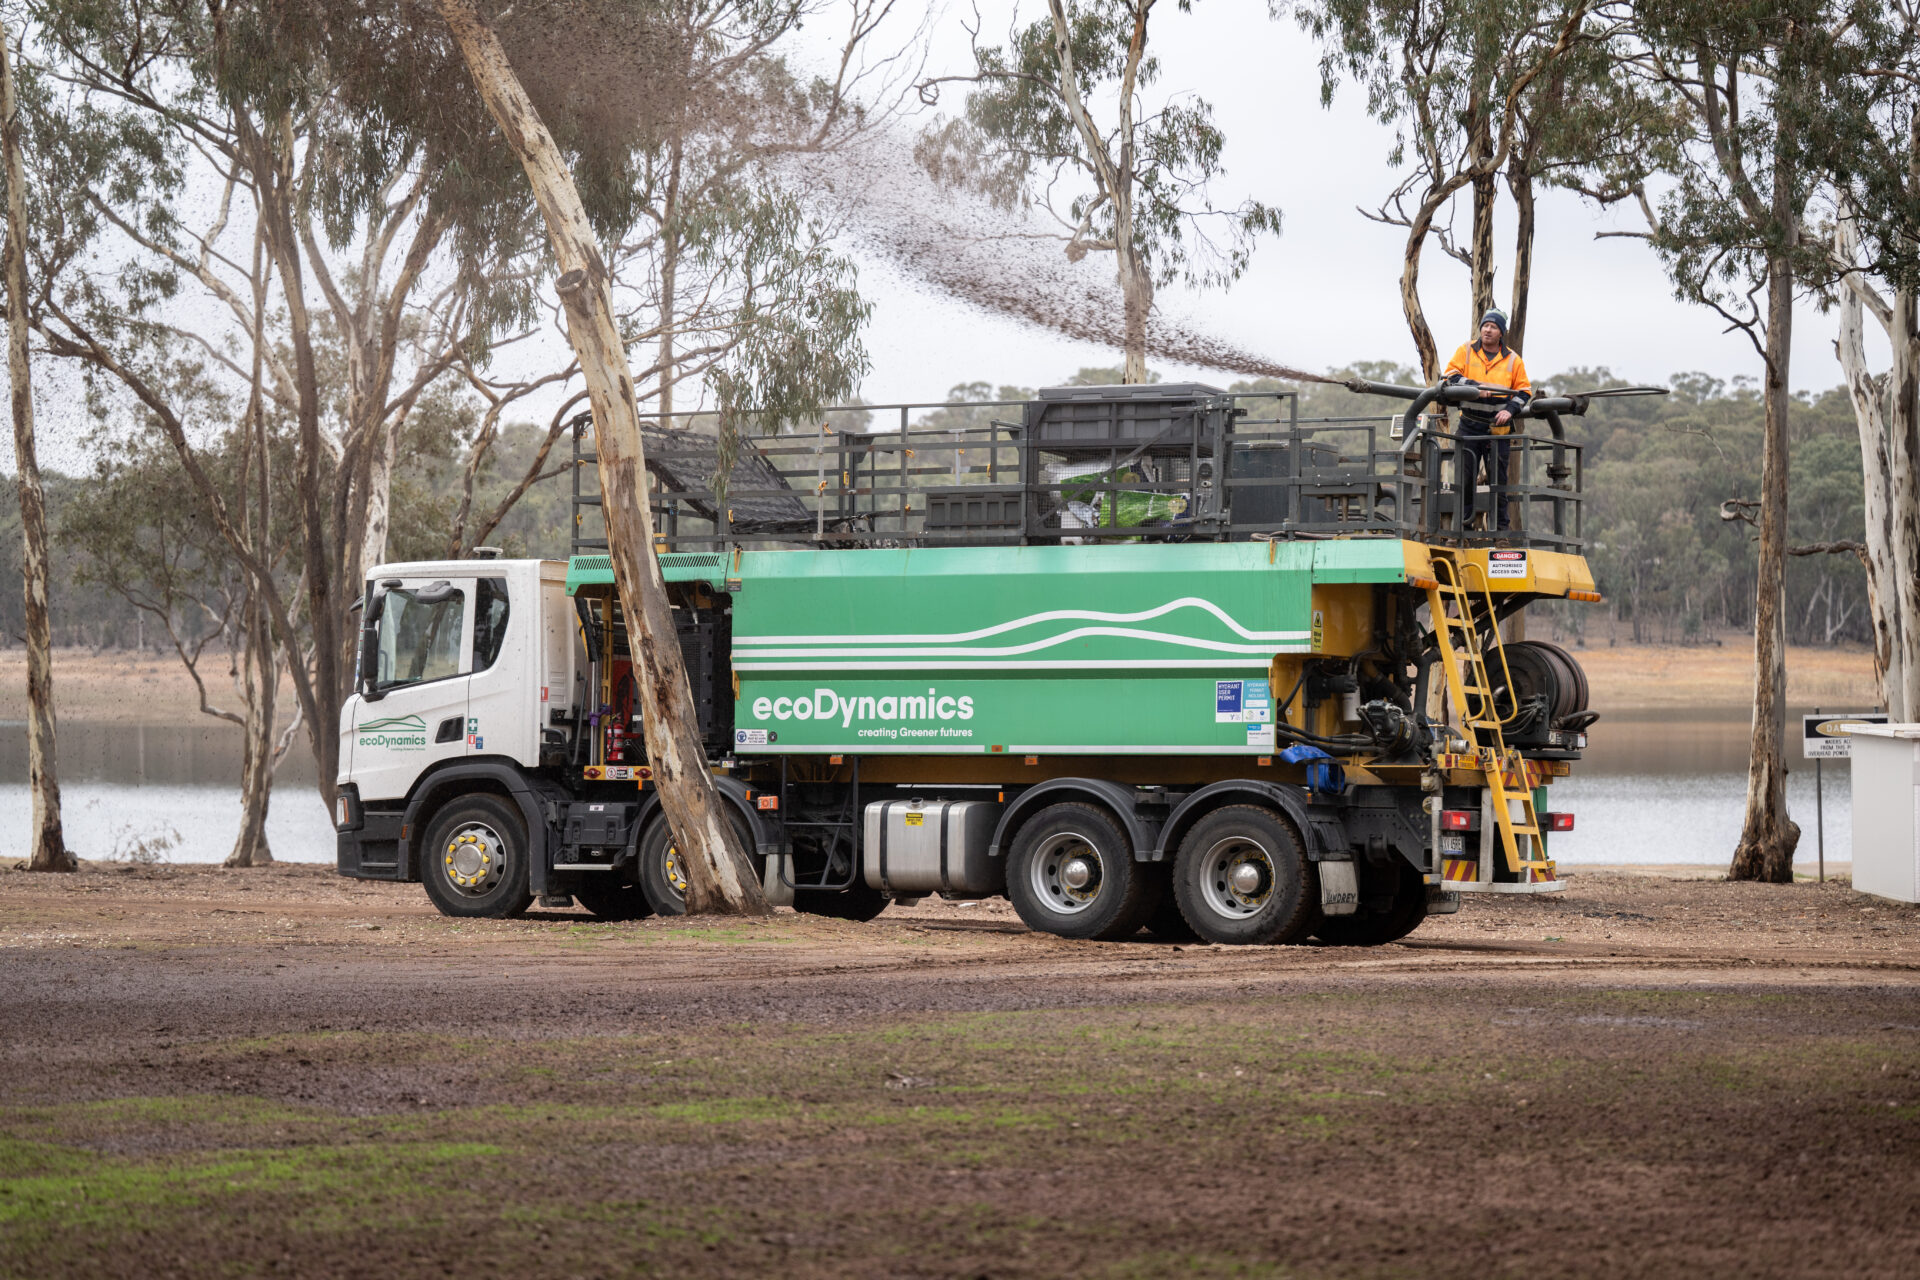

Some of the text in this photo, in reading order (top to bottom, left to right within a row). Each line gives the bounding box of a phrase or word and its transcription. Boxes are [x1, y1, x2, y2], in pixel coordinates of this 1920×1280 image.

[752, 688, 974, 728] ecoDynamics
[858, 727, 973, 739] creating Greener futures
[359, 734, 426, 748] ecoDynamics
